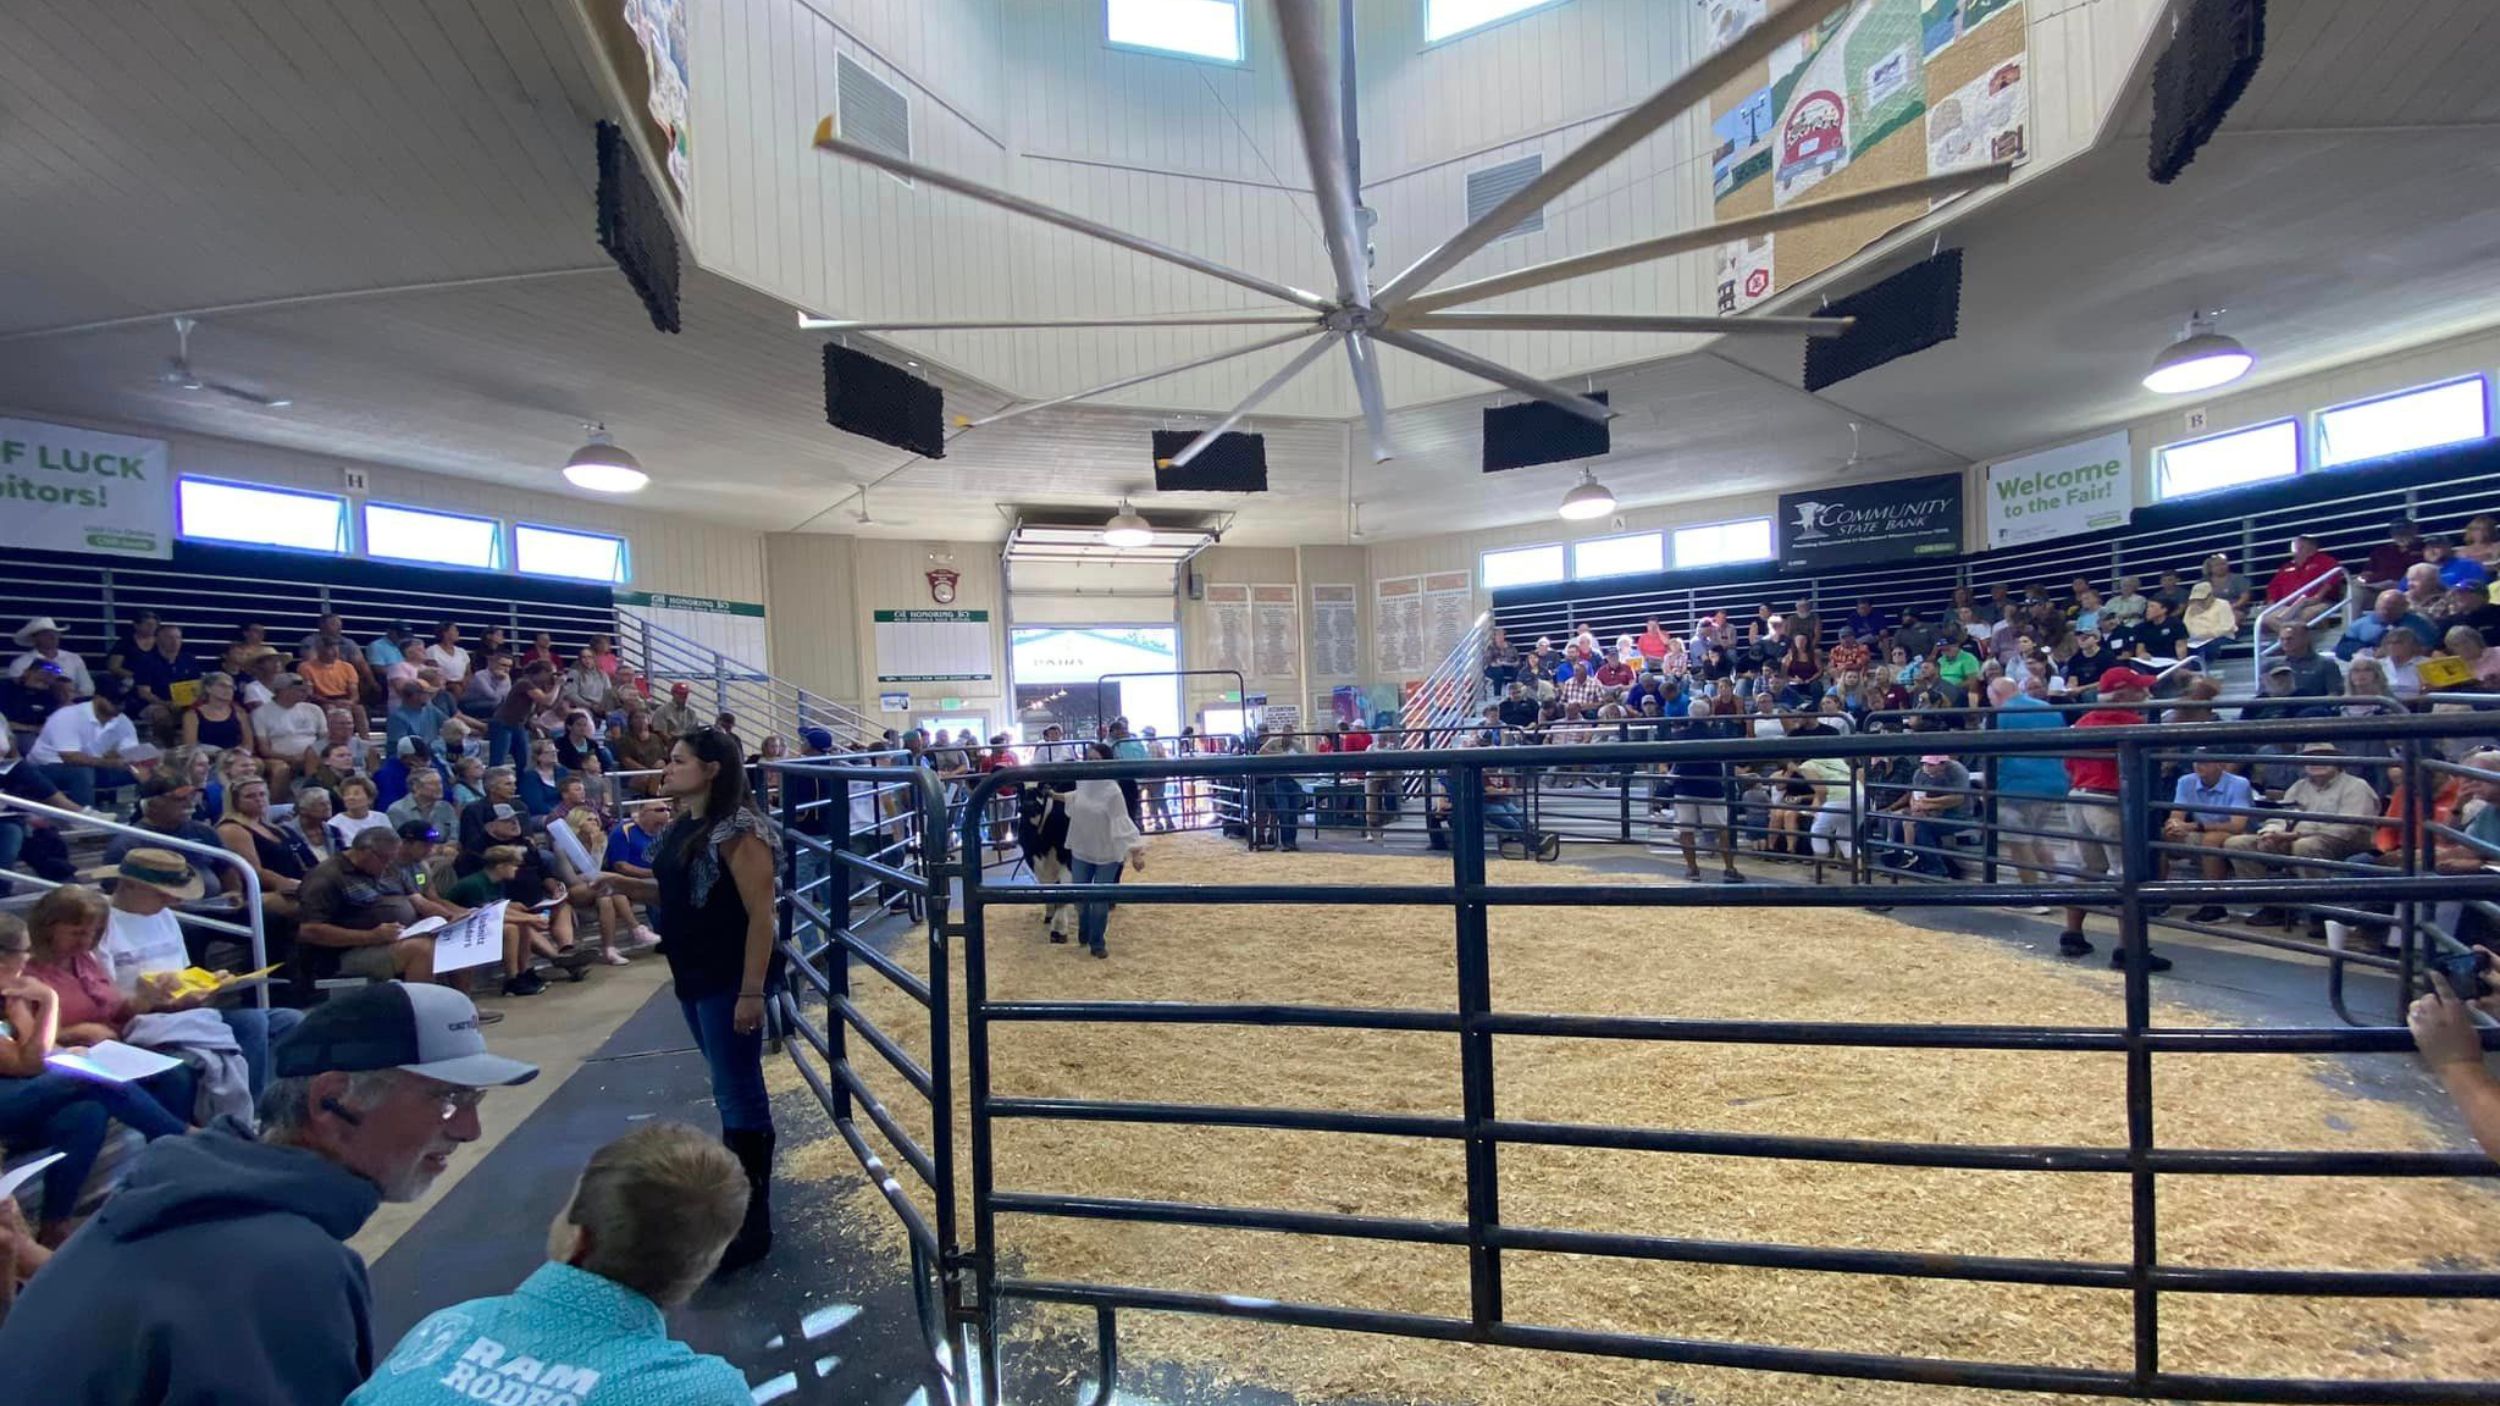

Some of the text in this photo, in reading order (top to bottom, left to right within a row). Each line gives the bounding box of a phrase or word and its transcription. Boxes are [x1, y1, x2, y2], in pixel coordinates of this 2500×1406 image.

[38, 444, 146, 481] LUCK
[347, 473, 364, 488] H
[1995, 458, 2121, 501] Welcome
[0, 473, 107, 508] itors!
[2004, 481, 2112, 519] to the Fair!
[1818, 497, 1954, 527] COMMUNITY
[1837, 516, 1929, 537] STATE BANK
[462, 1336, 601, 1398] RAM
